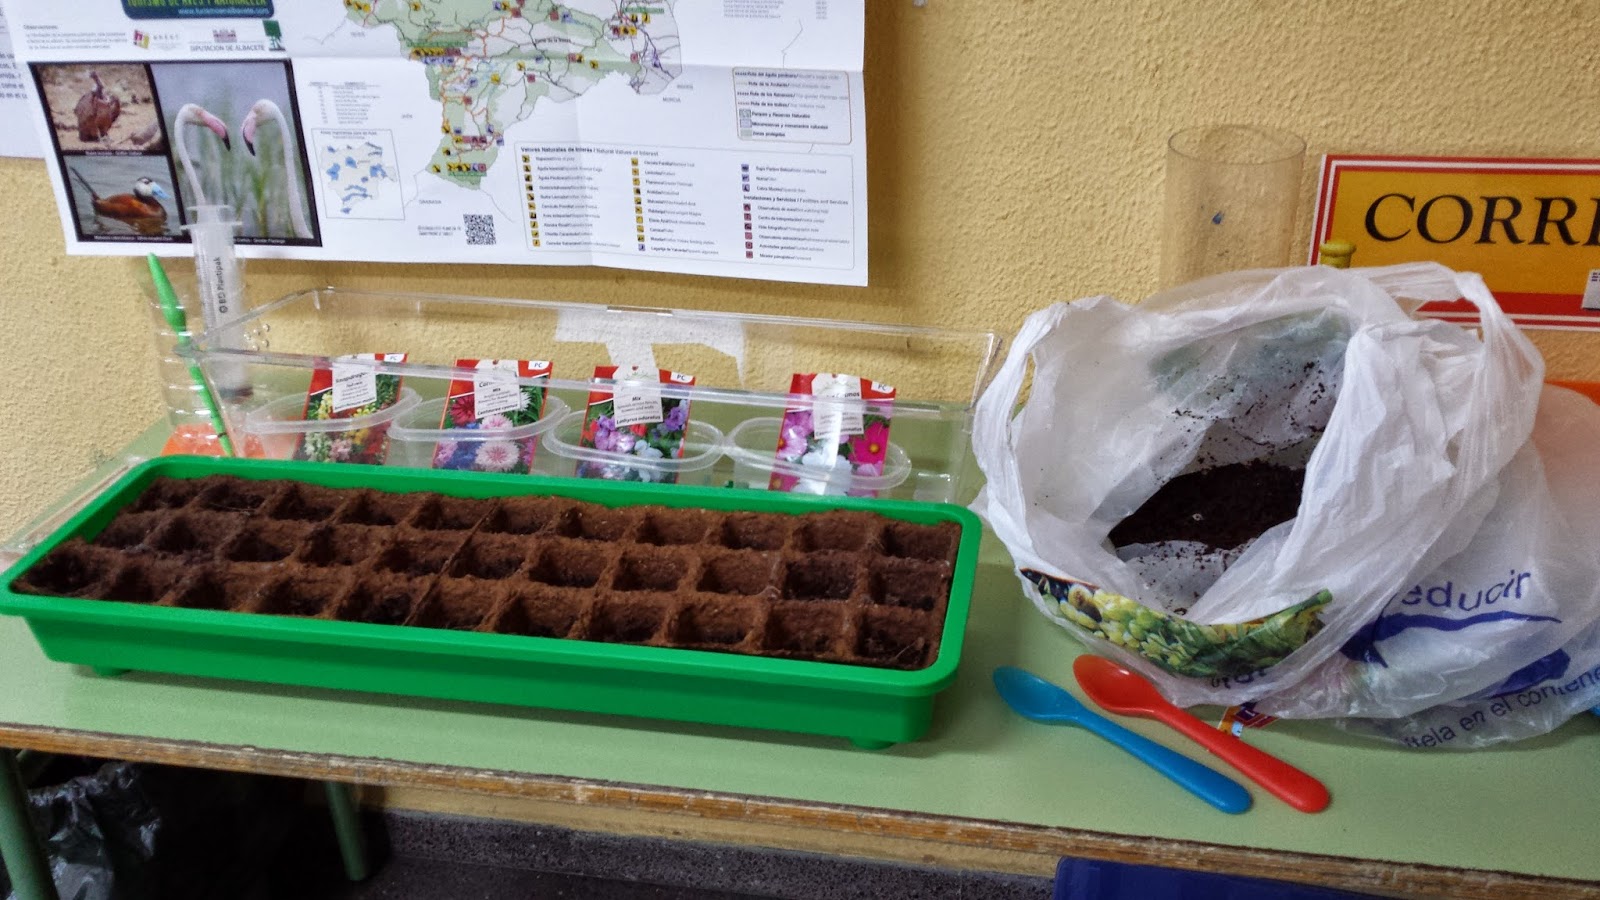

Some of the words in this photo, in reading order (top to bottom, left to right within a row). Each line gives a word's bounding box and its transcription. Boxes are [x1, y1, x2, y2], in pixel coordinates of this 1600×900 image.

[213, 256, 224, 291] Plastipak
[1459, 710, 1486, 732] en
[1491, 697, 1513, 716] el
